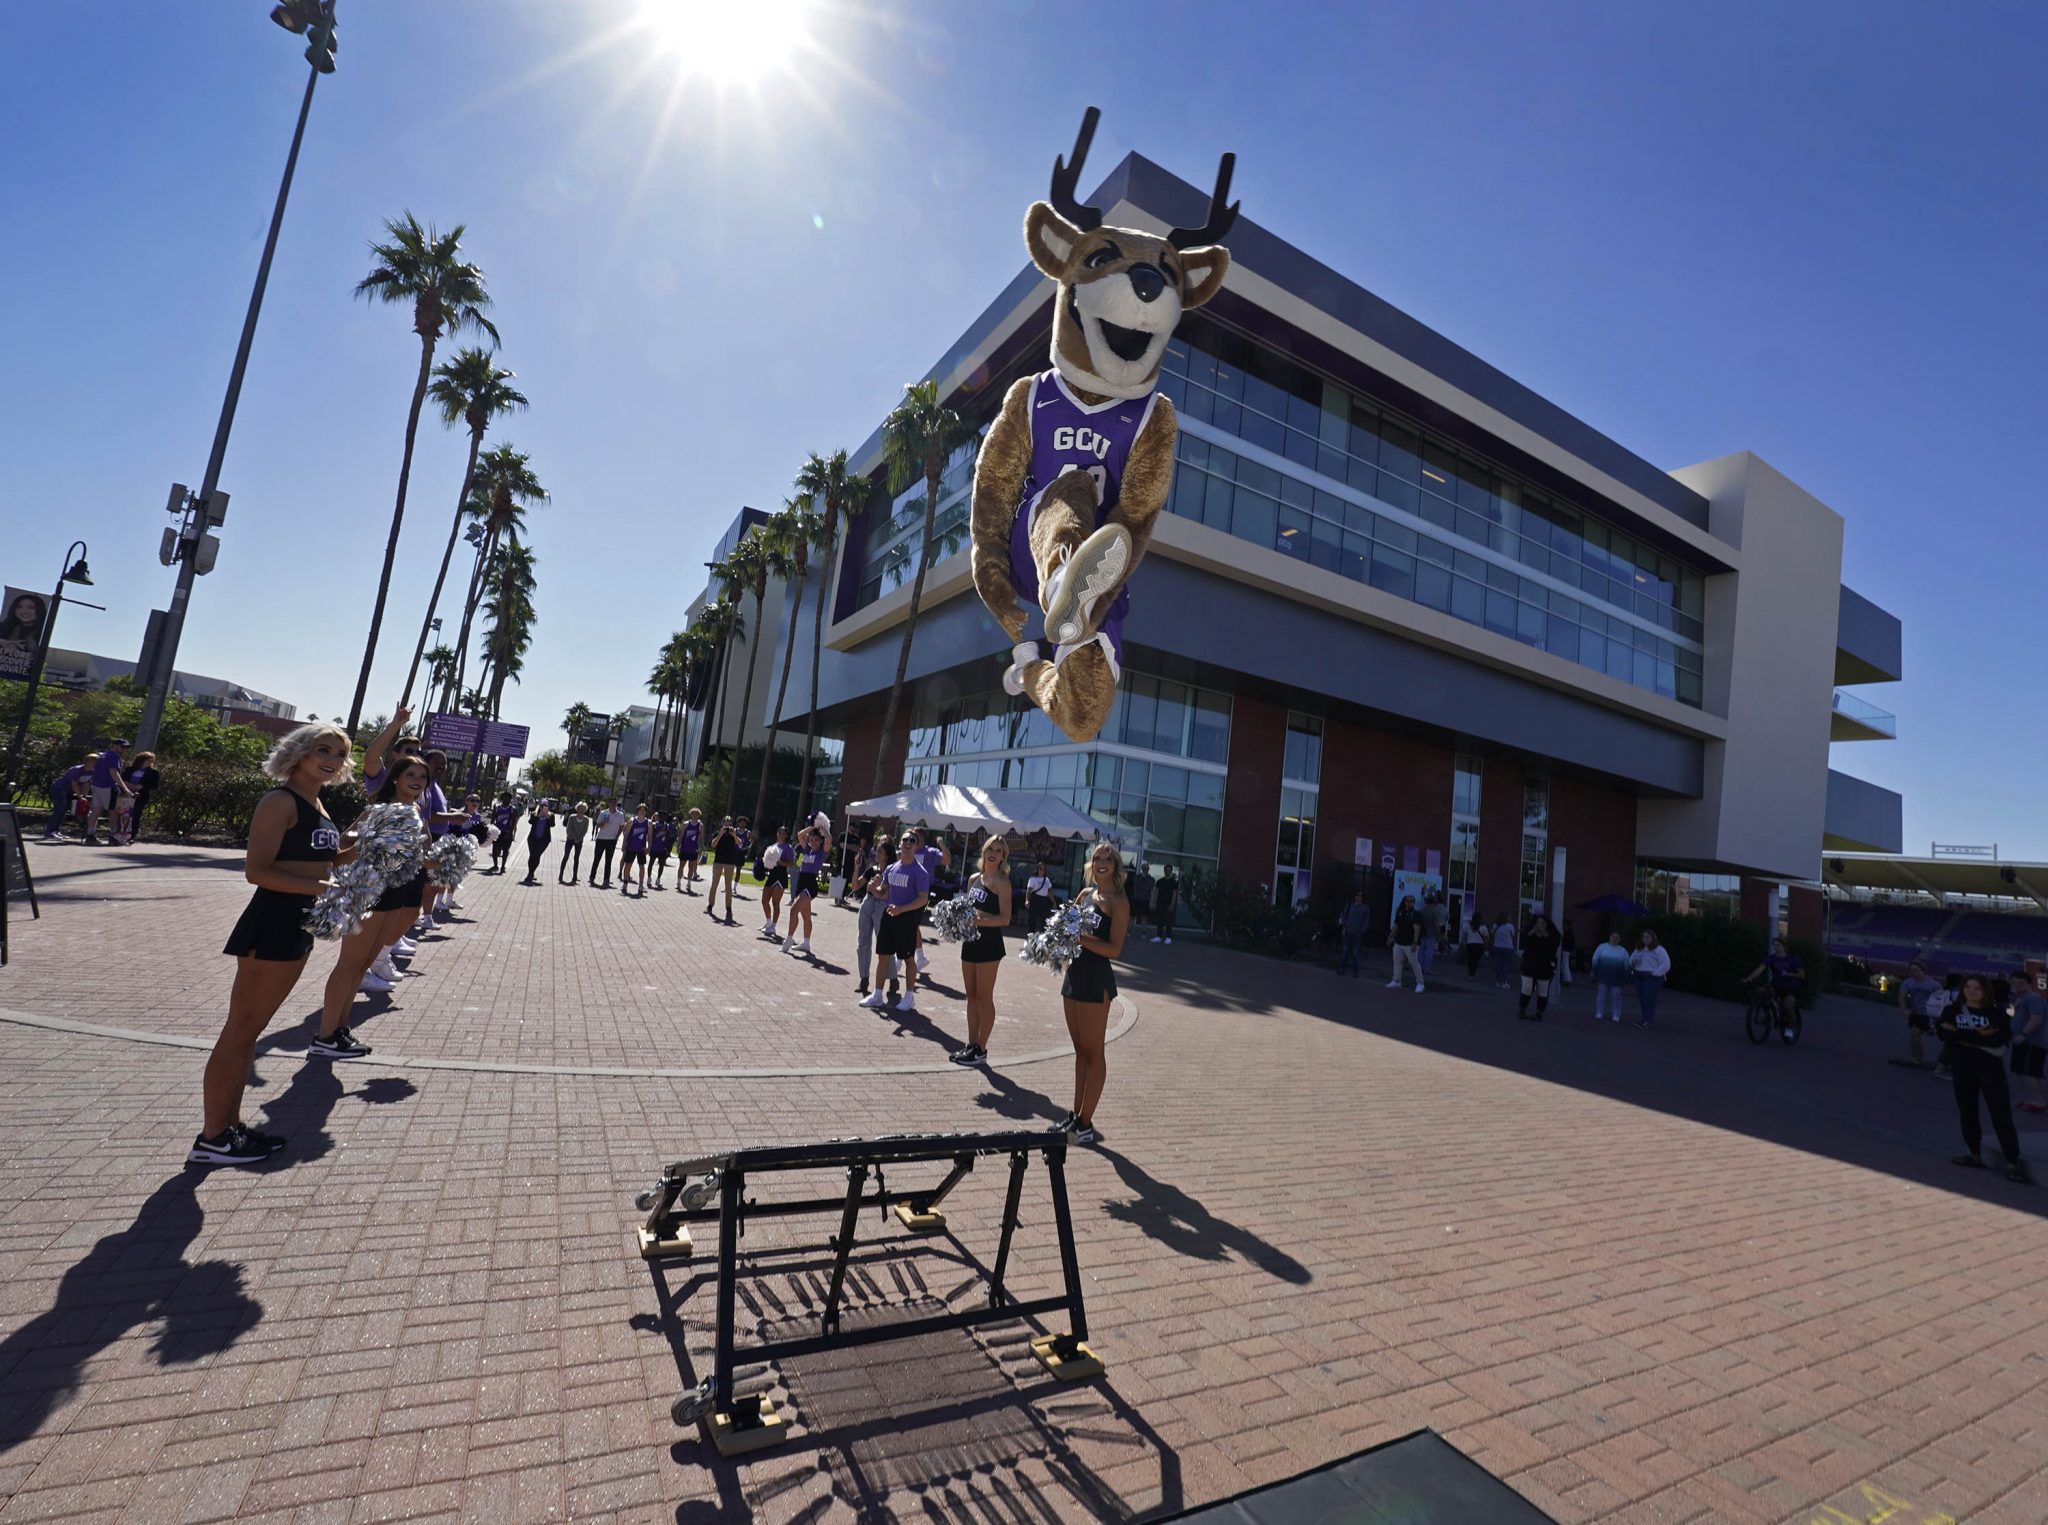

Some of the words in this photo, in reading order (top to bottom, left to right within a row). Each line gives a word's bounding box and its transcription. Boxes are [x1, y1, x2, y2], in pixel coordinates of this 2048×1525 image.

[1053, 427, 1111, 460] GCU
[311, 829, 340, 849] GC
[2037, 978, 2047, 990] 5
